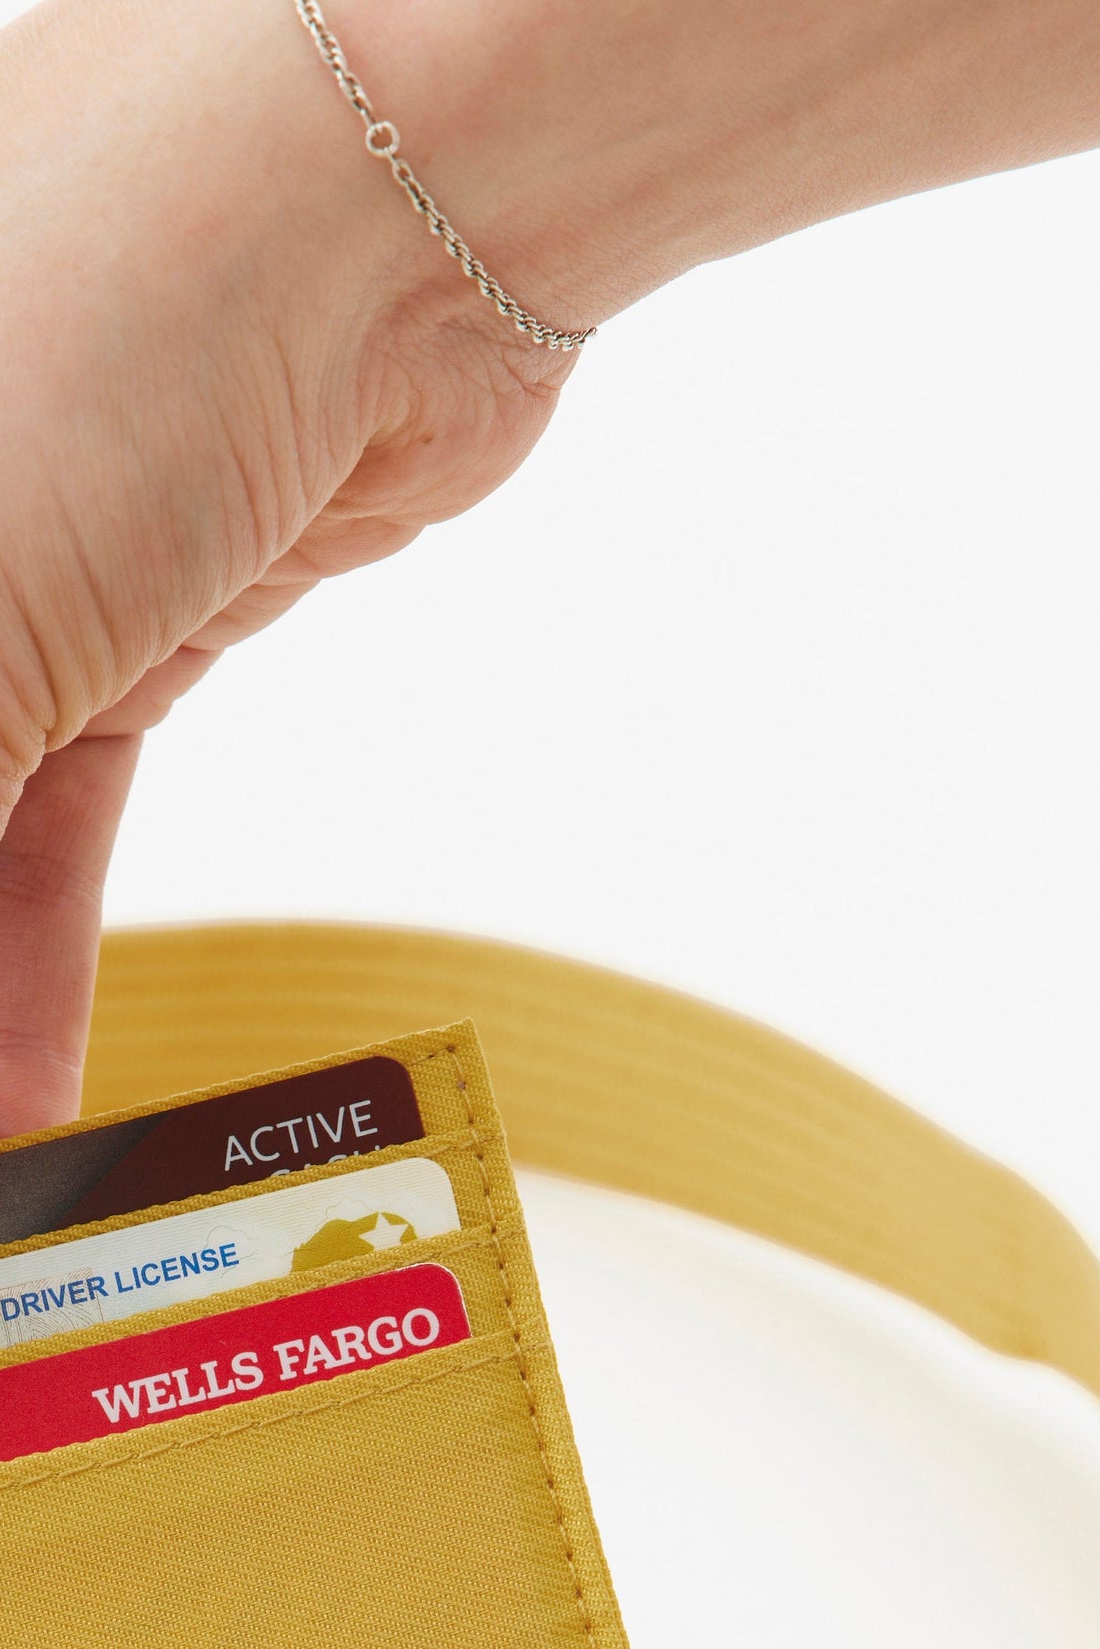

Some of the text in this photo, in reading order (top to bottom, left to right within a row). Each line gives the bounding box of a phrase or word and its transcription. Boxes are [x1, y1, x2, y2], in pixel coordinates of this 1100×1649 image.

[225, 1099, 379, 1172] ACTIVE
[0, 1275, 110, 1322] DRIVER
[113, 1242, 240, 1294] LICENSE
[91, 1307, 441, 1424] WELLS FARGO
